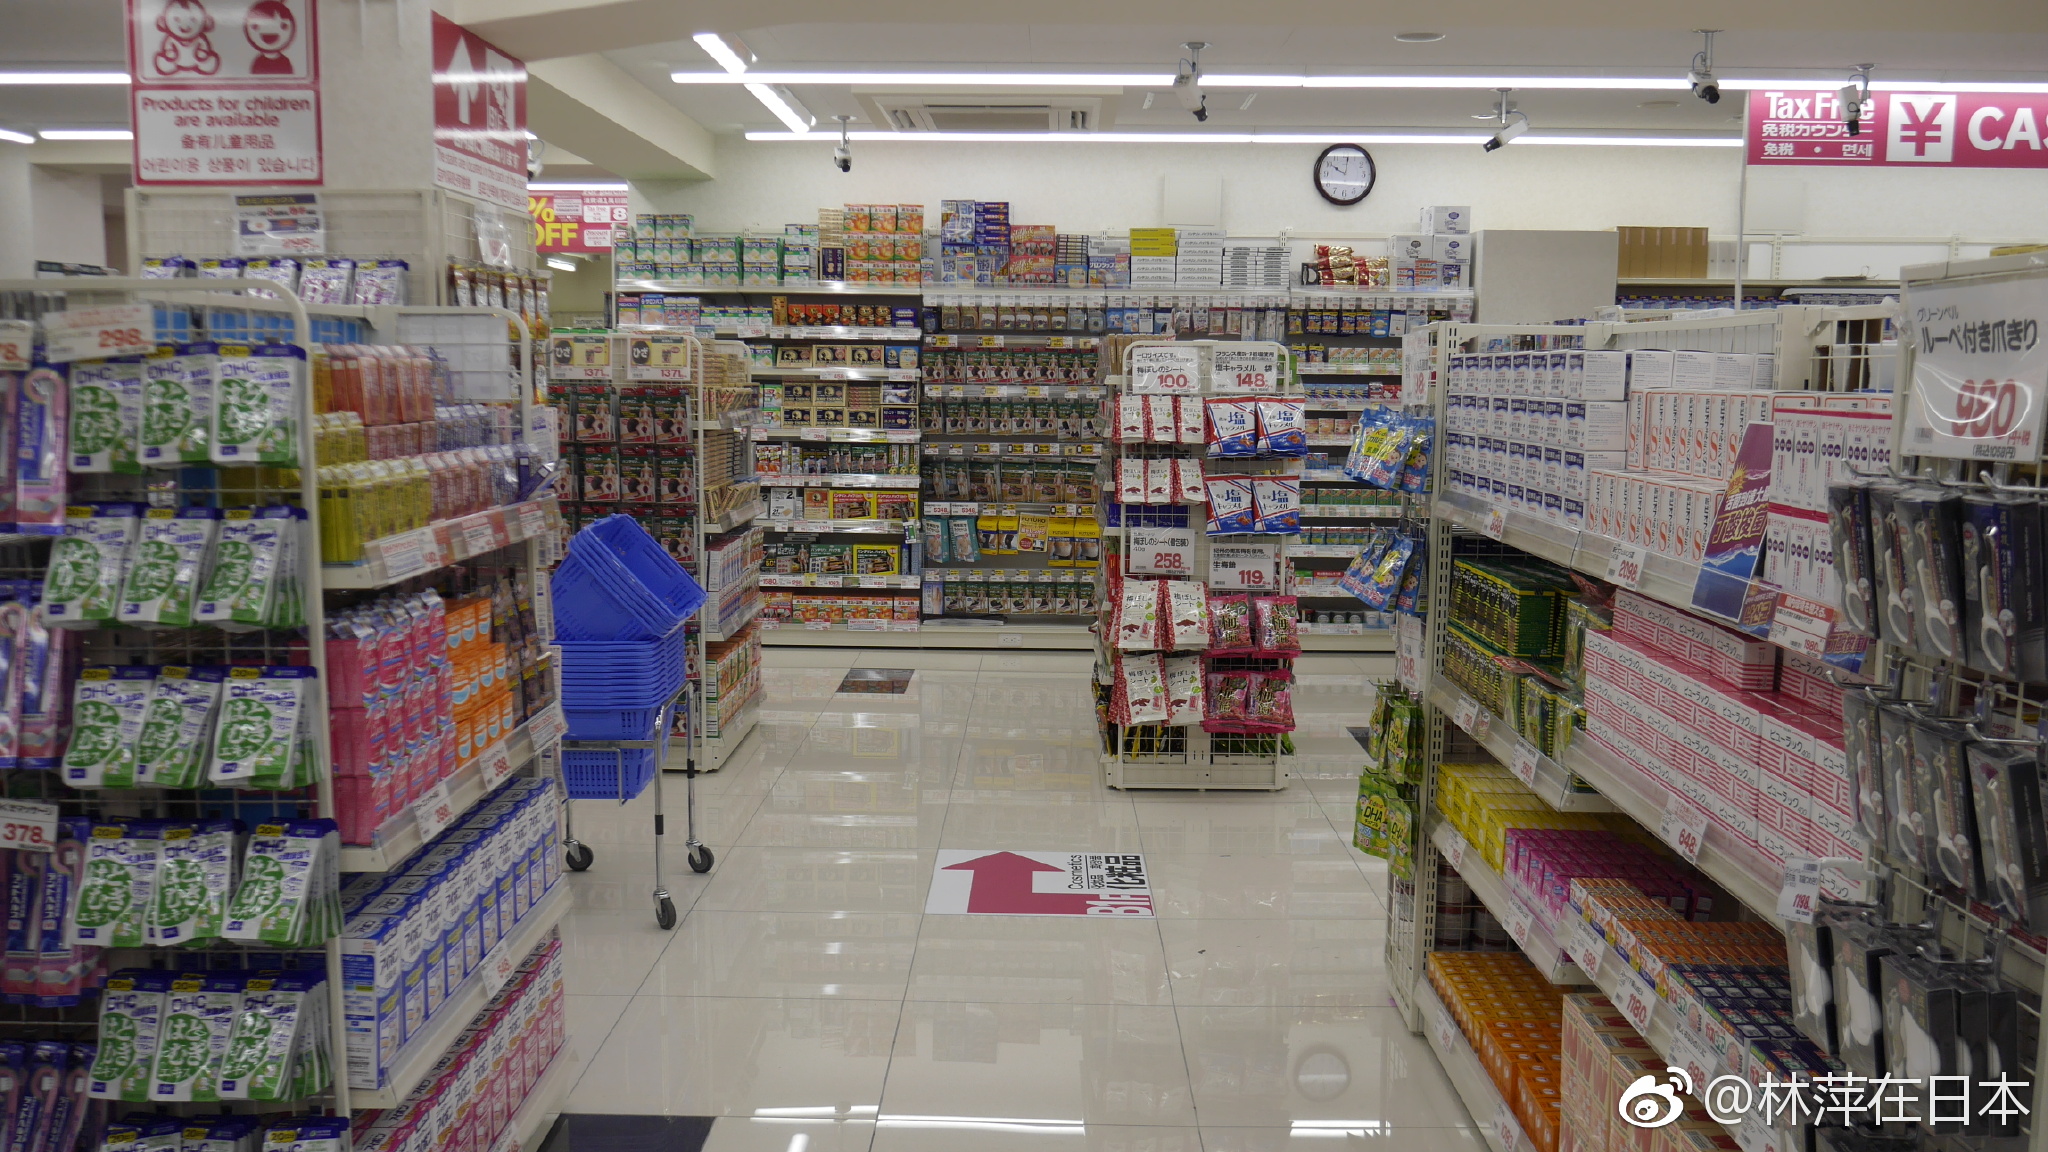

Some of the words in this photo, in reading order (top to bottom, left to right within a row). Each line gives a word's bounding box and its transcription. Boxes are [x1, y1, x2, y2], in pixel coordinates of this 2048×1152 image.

[142, 96, 213, 112] Products
[218, 96, 239, 111] for
[245, 96, 311, 111] children
[1765, 92, 1811, 119] Tax
[1815, 93, 1875, 120] Fre
[174, 114, 200, 127] are
[205, 112, 280, 127] available
[1762, 123, 1873, 137] 免税カウンー
[1764, 142, 1794, 155] 免税
[1842, 143, 1872, 157] 면세
[207, 157, 250, 173] 상품이
[257, 156, 315, 173] 있습니다
[1917, 305, 1959, 322] グリーンベル
[99, 329, 143, 348] 298
[1922, 319, 2037, 354] ルーペ付き爪きり
[555, 346, 572, 358] ひざ
[633, 346, 649, 358] ひざ
[1157, 374, 1188, 388] 100
[1236, 373, 1265, 387] 148
[1154, 553, 1181, 568] 258
[1238, 570, 1263, 584] 119
[1618, 560, 1639, 582] 2098
[1363, 806, 1383, 822] DHA
[2, 823, 43, 843] 378
[1678, 828, 1696, 853] 648
[1068, 855, 1083, 889] Cosmetics
[1105, 855, 1147, 889] 化粧品
[1793, 893, 1810, 910] 1198
[1627, 993, 1647, 1025] 1180
